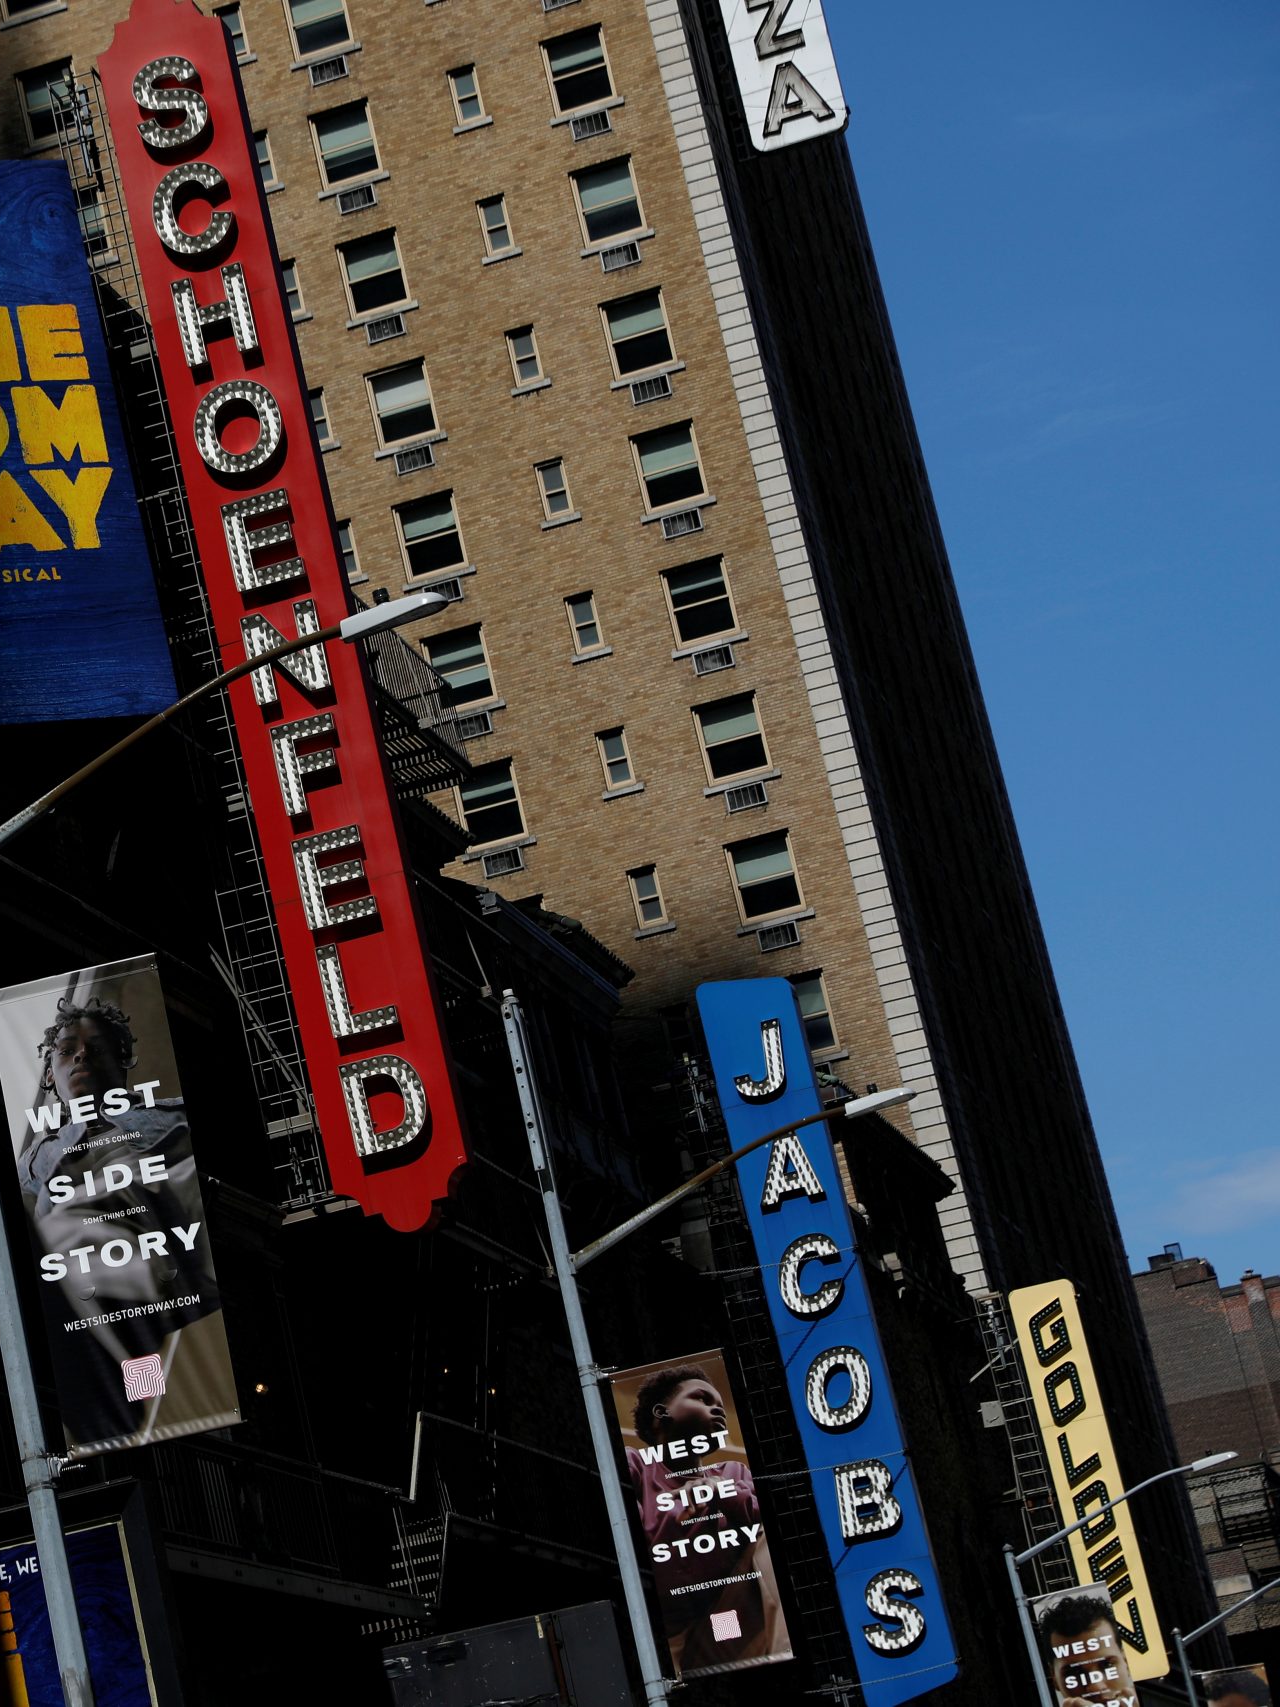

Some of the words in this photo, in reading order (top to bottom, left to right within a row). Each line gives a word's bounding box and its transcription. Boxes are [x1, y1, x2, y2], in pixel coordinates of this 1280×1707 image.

[132, 55, 430, 1160] SCHOENFELD
[24, 1080, 162, 1134] WEST
[62, 1138, 111, 1155] SOMETHING'S
[111, 1131, 143, 1143] COMING.
[47, 1154, 169, 1204] SIDE
[82, 1210, 126, 1225] SOMETHING
[126, 1205, 149, 1216] GOOD.
[39, 1222, 202, 1282] STORY
[64, 1294, 201, 1332] WESTSIDESTORYBWAY.COM
[733, 1018, 926, 1660] JACOBS
[638, 1430, 730, 1465] WEST
[656, 1479, 738, 1512] SIDE
[652, 1523, 761, 1564] STORY
[15, 1555, 39, 1575] WE
[669, 1570, 763, 1596] WESTSIDESTORYBWAY.COM
[1052, 1635, 1113, 1659] WEST
[1064, 1666, 1120, 1689] SIDE
